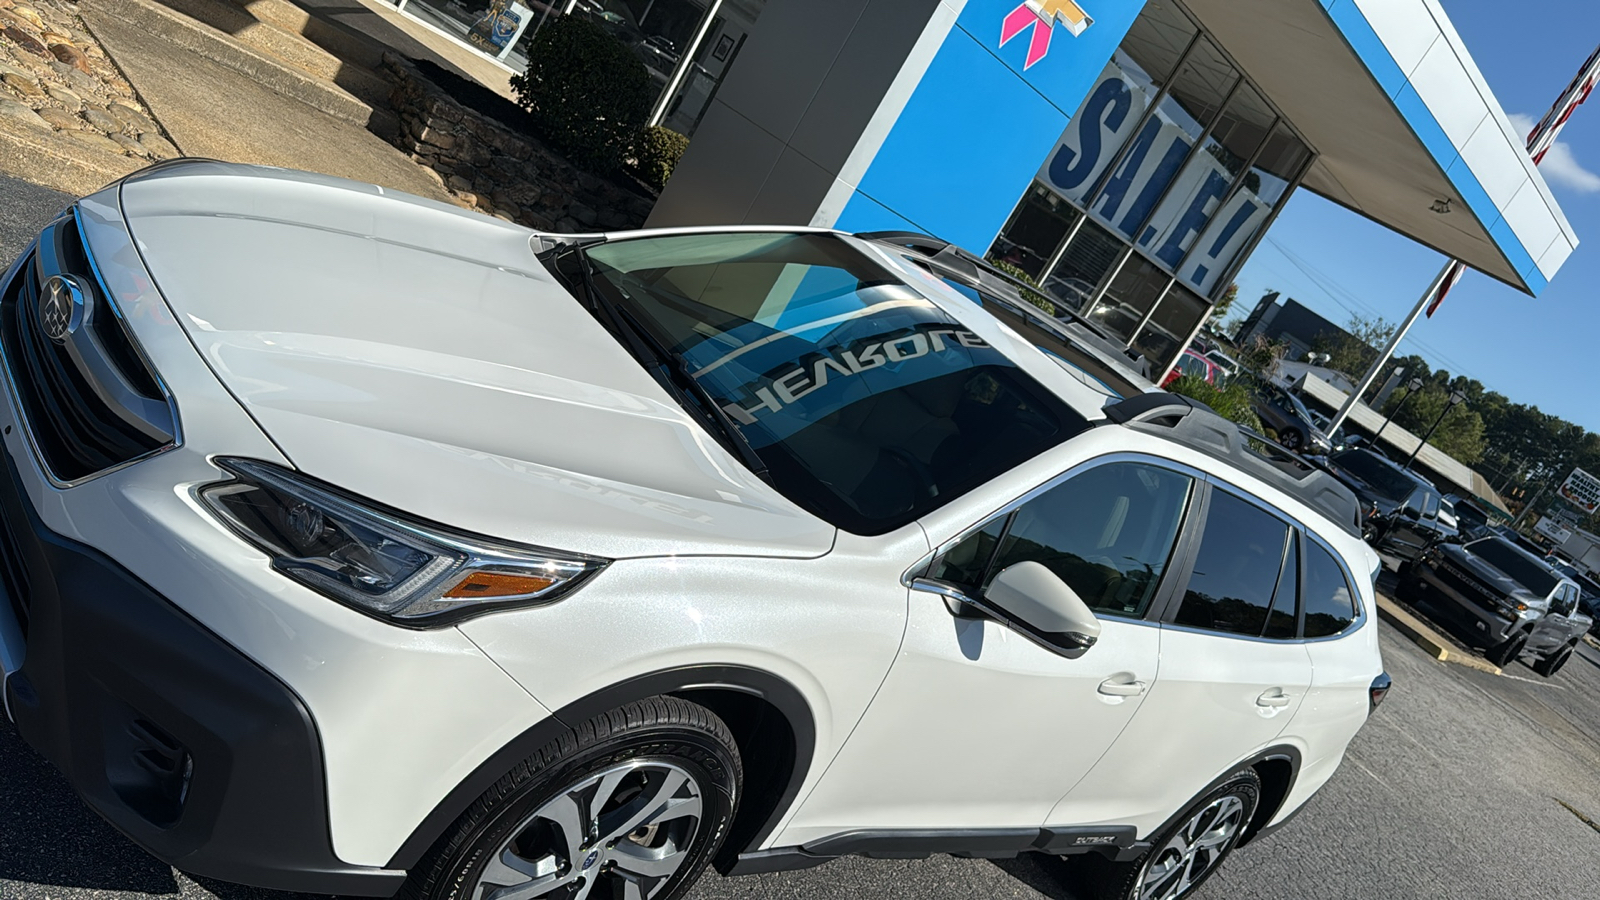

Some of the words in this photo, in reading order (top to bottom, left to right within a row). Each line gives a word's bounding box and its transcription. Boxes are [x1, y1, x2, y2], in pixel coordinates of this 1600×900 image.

[1049, 77, 1259, 286] SALE!
[1570, 480, 1600, 499] HARVEST
[1571, 473, 1600, 492] HEALTHY
[1569, 486, 1600, 506] PRODUCE
